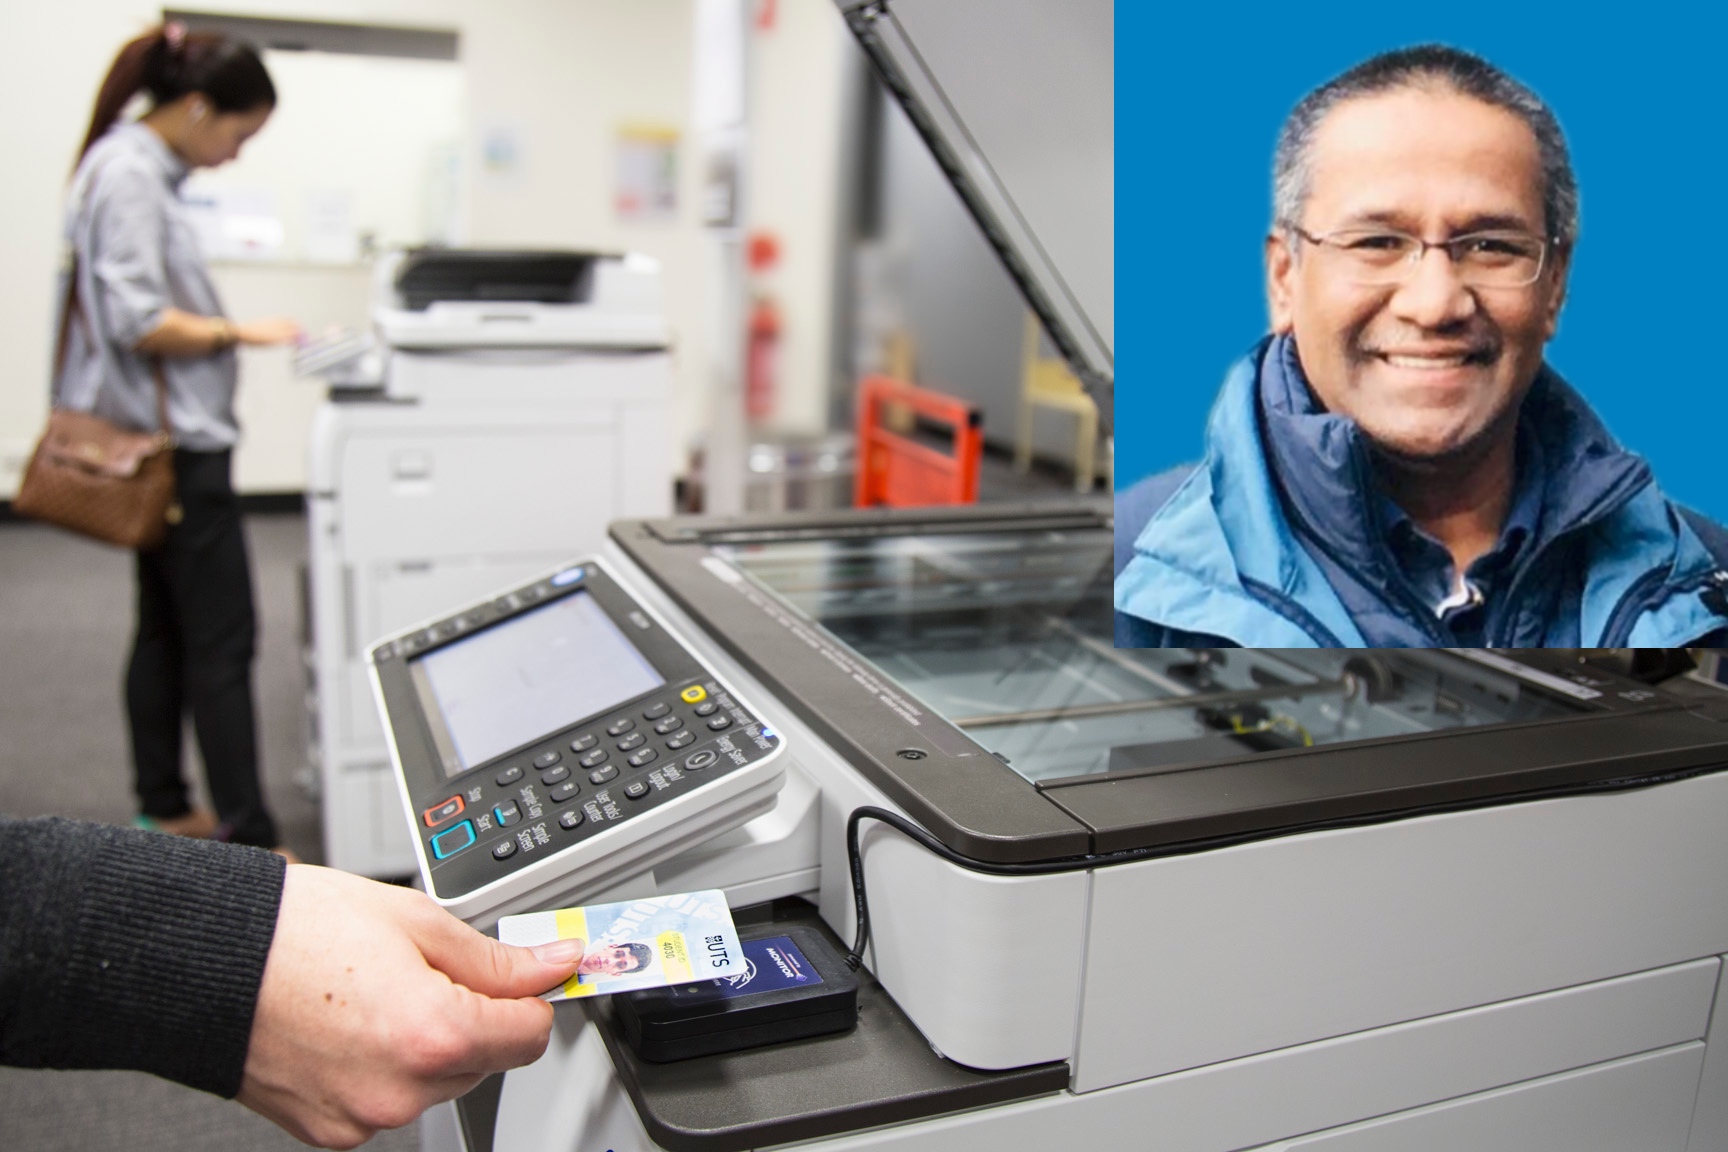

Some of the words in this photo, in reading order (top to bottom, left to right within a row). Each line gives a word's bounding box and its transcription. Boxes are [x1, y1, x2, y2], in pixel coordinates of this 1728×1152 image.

[716, 734, 737, 753] Energy
[728, 748, 749, 765] Saver
[753, 735, 773, 750] Power
[648, 769, 671, 791] Logout
[662, 763, 685, 781] Login/
[595, 789, 612, 805] User
[583, 800, 604, 823] Counter
[603, 800, 623, 820] Tools/
[477, 814, 493, 833] Start
[532, 822, 552, 846] Simple
[517, 829, 535, 852] Screen
[663, 942, 675, 959] 4030
[707, 942, 730, 968] UTS
[766, 948, 795, 979] MONITOR
